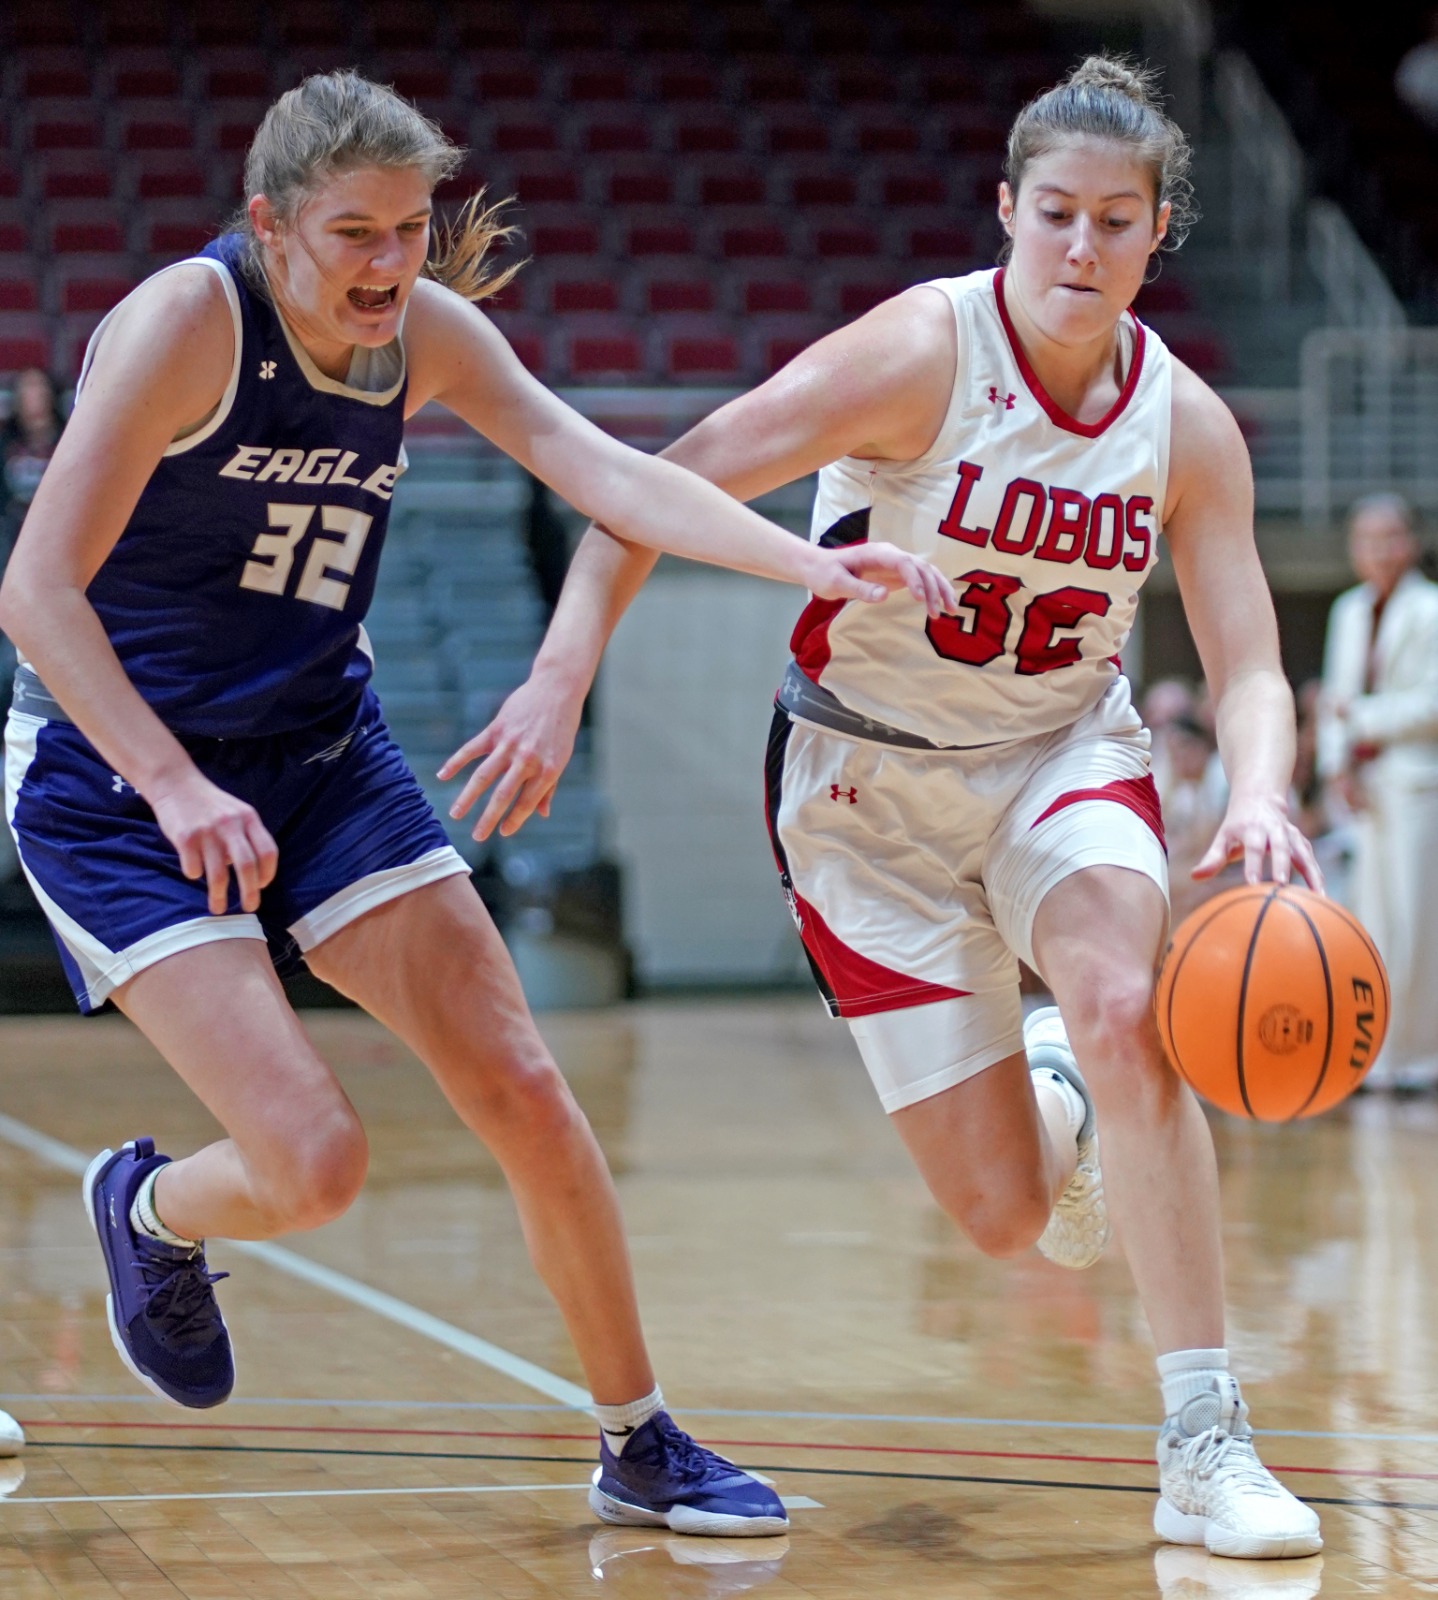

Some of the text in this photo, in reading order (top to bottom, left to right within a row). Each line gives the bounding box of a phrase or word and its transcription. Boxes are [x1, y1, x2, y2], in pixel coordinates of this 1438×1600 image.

[239, 502, 374, 611] 32
[938, 460, 1154, 572] LOBOS
[924, 568, 1113, 676] 32
